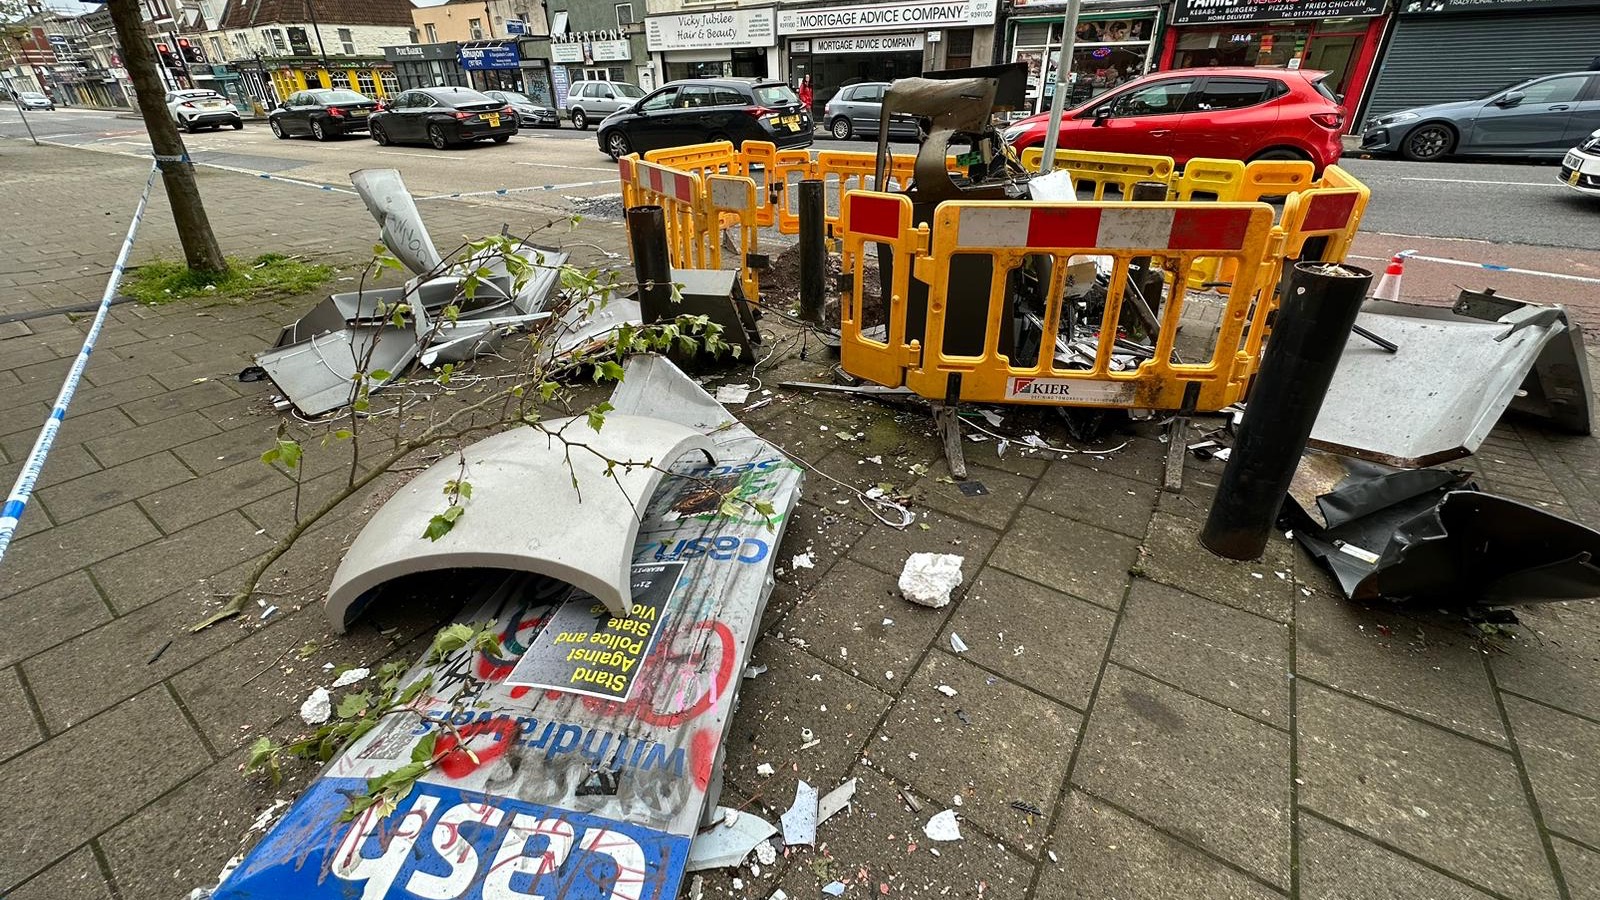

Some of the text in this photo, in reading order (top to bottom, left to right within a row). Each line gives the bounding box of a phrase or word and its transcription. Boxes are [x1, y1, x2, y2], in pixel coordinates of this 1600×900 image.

[800, 5, 964, 28] MORTGAGE ADVICE COMPANY
[1189, 8, 1216, 16] KEBABS
[1225, 6, 1258, 14] BURGERS
[1304, 2, 1327, 10] FRIED
[1328, 0, 1366, 9] CHICKEN
[677, 15, 699, 28] Vicky
[701, 13, 734, 26] Jubilee
[677, 28, 737, 40] Hair & Beauty
[818, 40, 853, 51] MORTGAGE
[855, 39, 879, 49] ADVICE
[882, 37, 917, 48] COMPANY
[1033, 383, 1070, 395] KIER
[607, 617, 651, 637] State
[554, 631, 644, 655] Police and
[566, 648, 636, 672] Against
[570, 667, 627, 692] Stand
